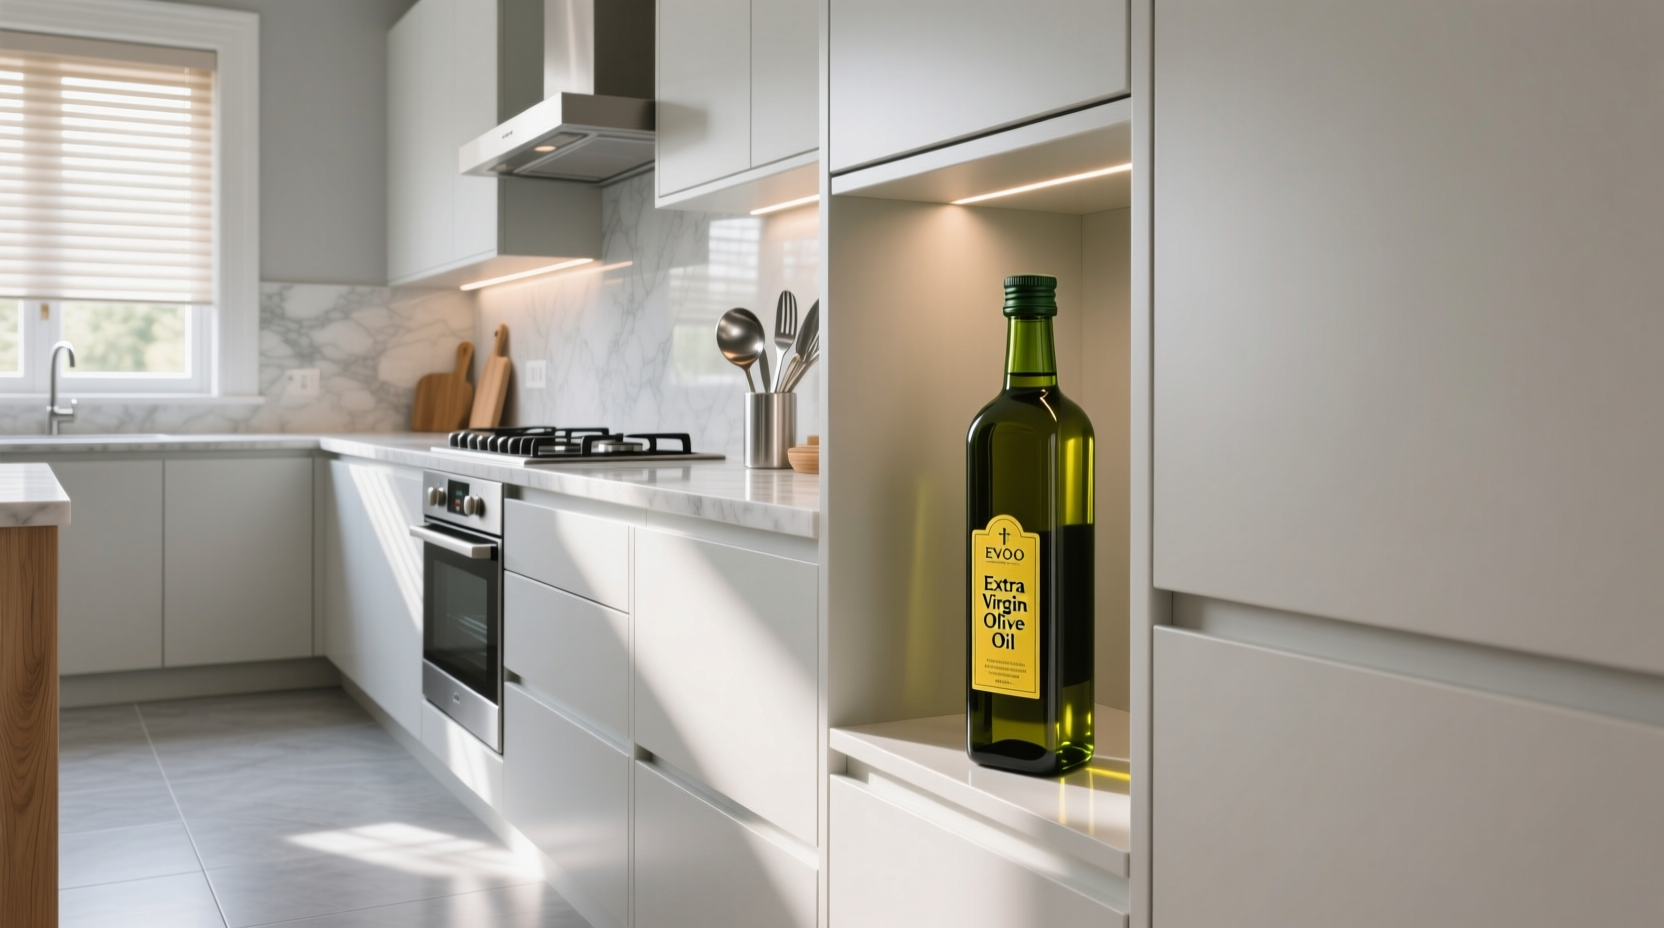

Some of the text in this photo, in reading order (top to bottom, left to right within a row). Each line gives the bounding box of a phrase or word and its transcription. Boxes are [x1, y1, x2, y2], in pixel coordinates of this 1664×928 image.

[985, 547, 1025, 561] EVOO
[984, 575, 1025, 593] Extra
[982, 593, 1028, 615] Virgin
[983, 612, 1025, 631] Olive
[992, 632, 1015, 650] Oil
